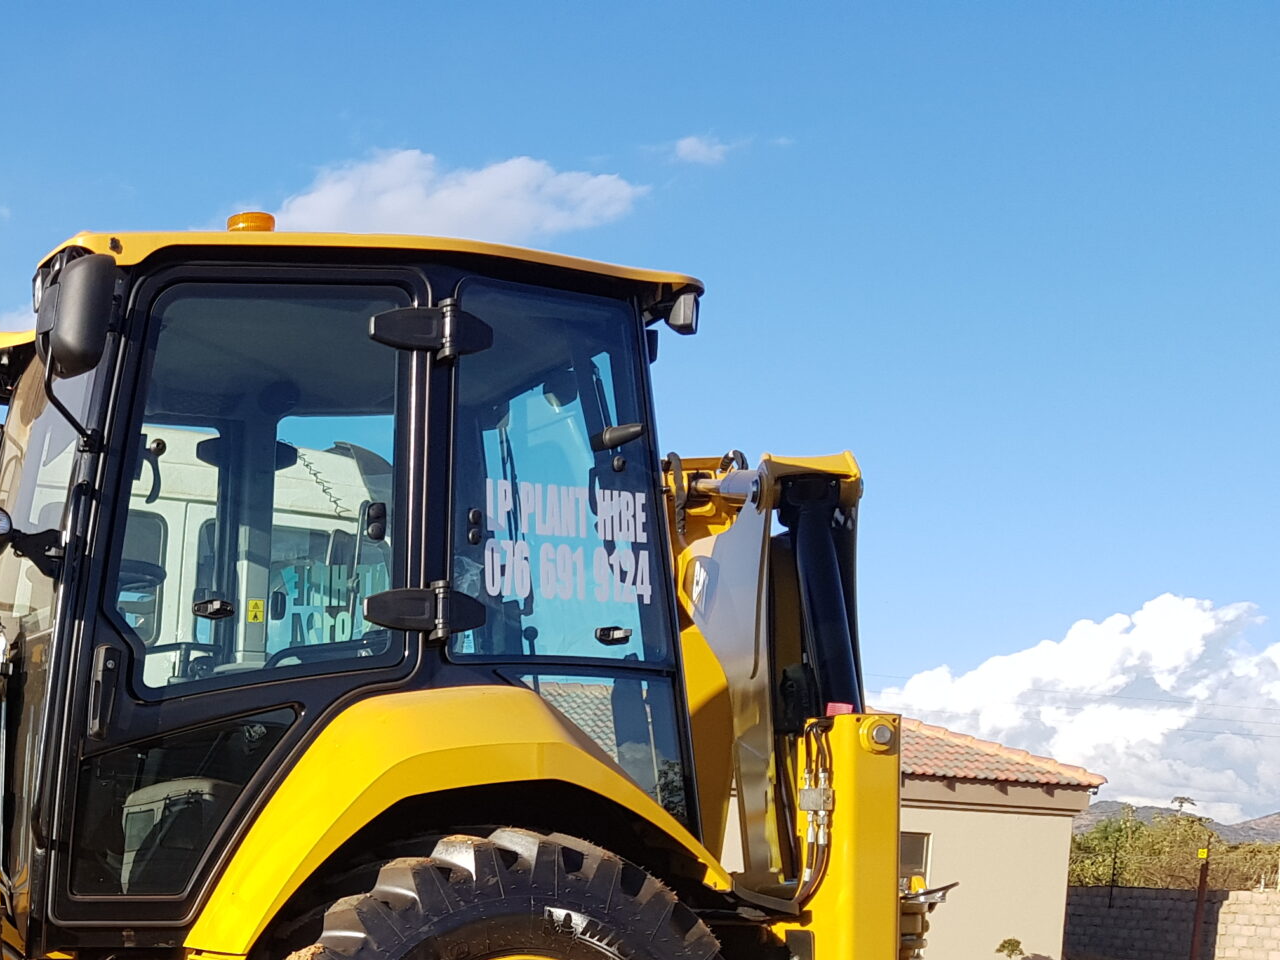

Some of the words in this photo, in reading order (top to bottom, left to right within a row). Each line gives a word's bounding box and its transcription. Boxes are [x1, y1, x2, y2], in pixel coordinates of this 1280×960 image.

[520, 482, 589, 538] PLANT
[597, 488, 648, 544] HIRE
[484, 538, 531, 599] 076
[539, 542, 585, 600] 691
[594, 546, 652, 604] 9124
